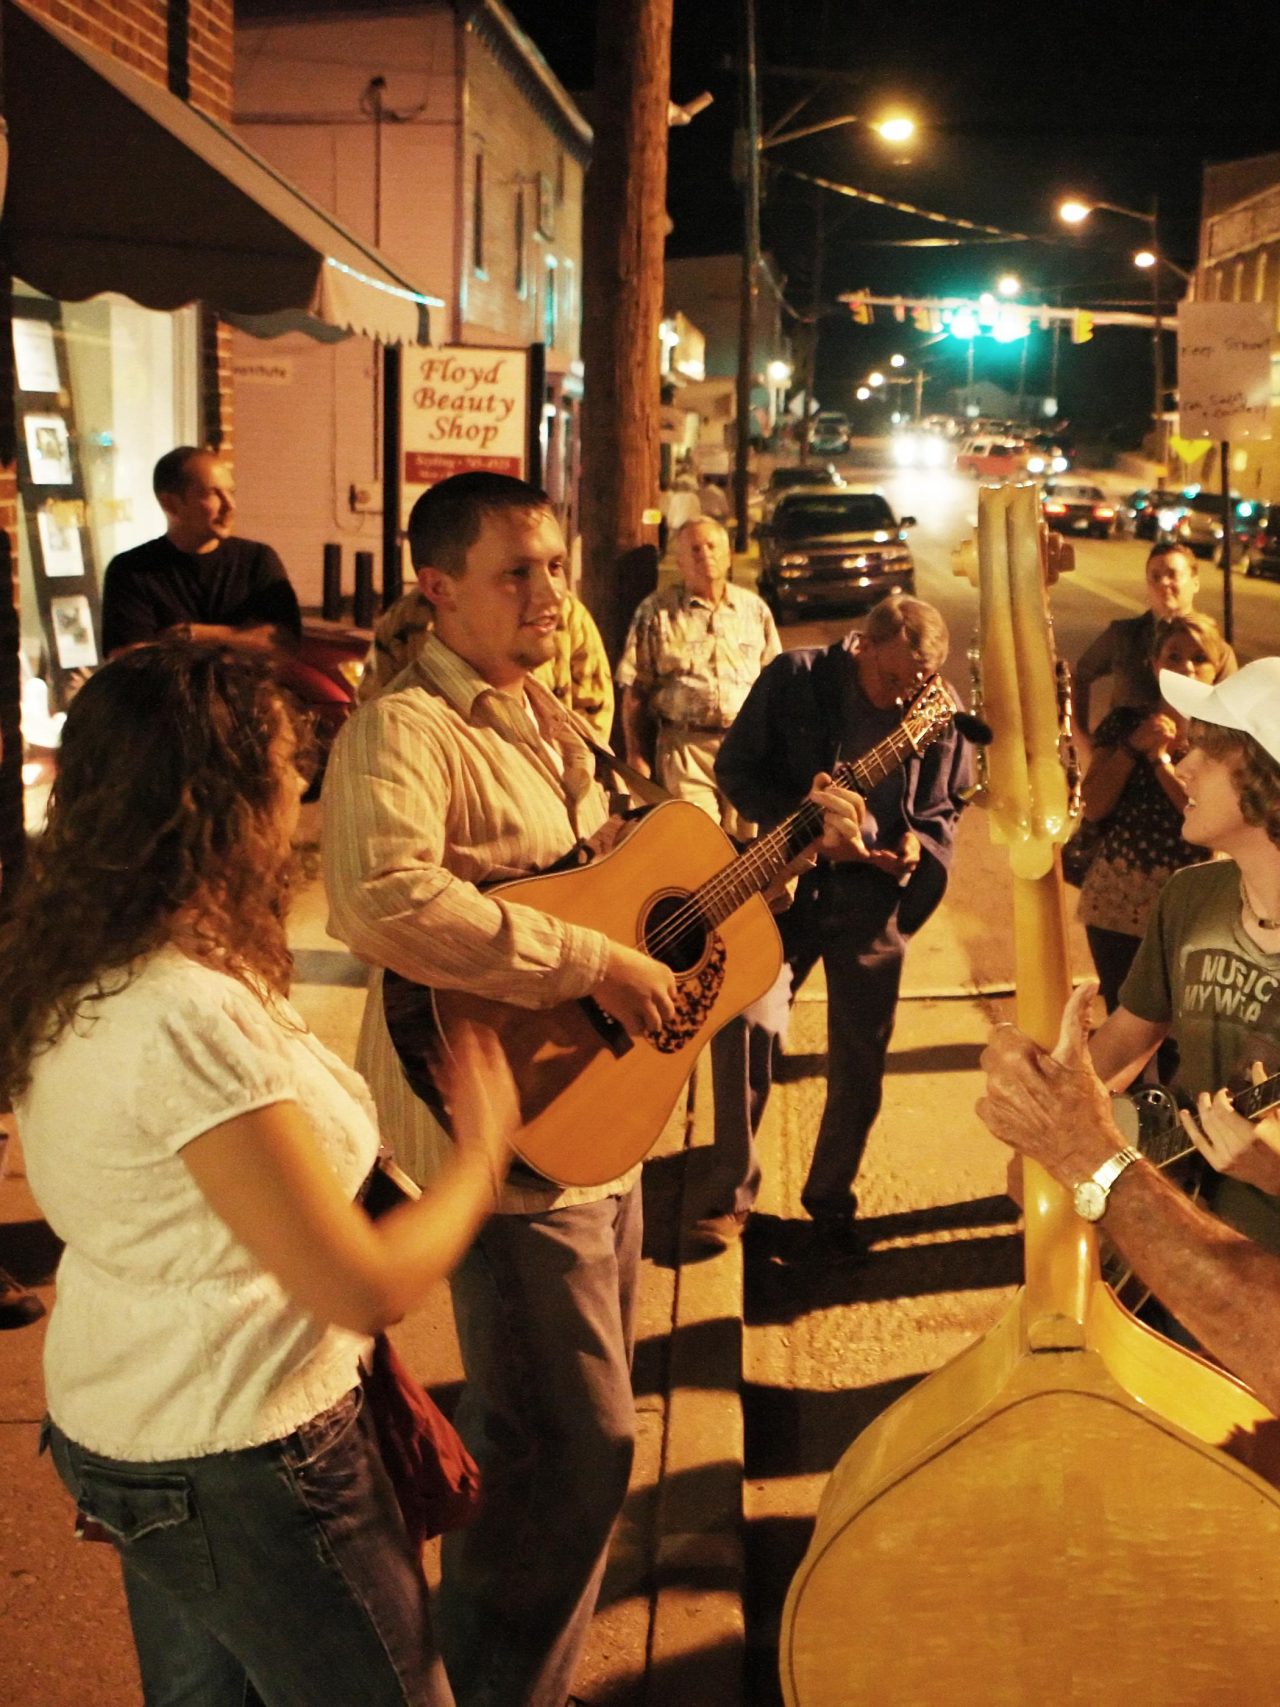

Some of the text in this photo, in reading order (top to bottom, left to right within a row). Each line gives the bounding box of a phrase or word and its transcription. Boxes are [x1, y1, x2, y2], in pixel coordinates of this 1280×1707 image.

[420, 356, 507, 391] Floyd
[413, 387, 515, 422] Beauty
[428, 416, 499, 449] Shop
[1201, 954, 1279, 1003] MUSIC
